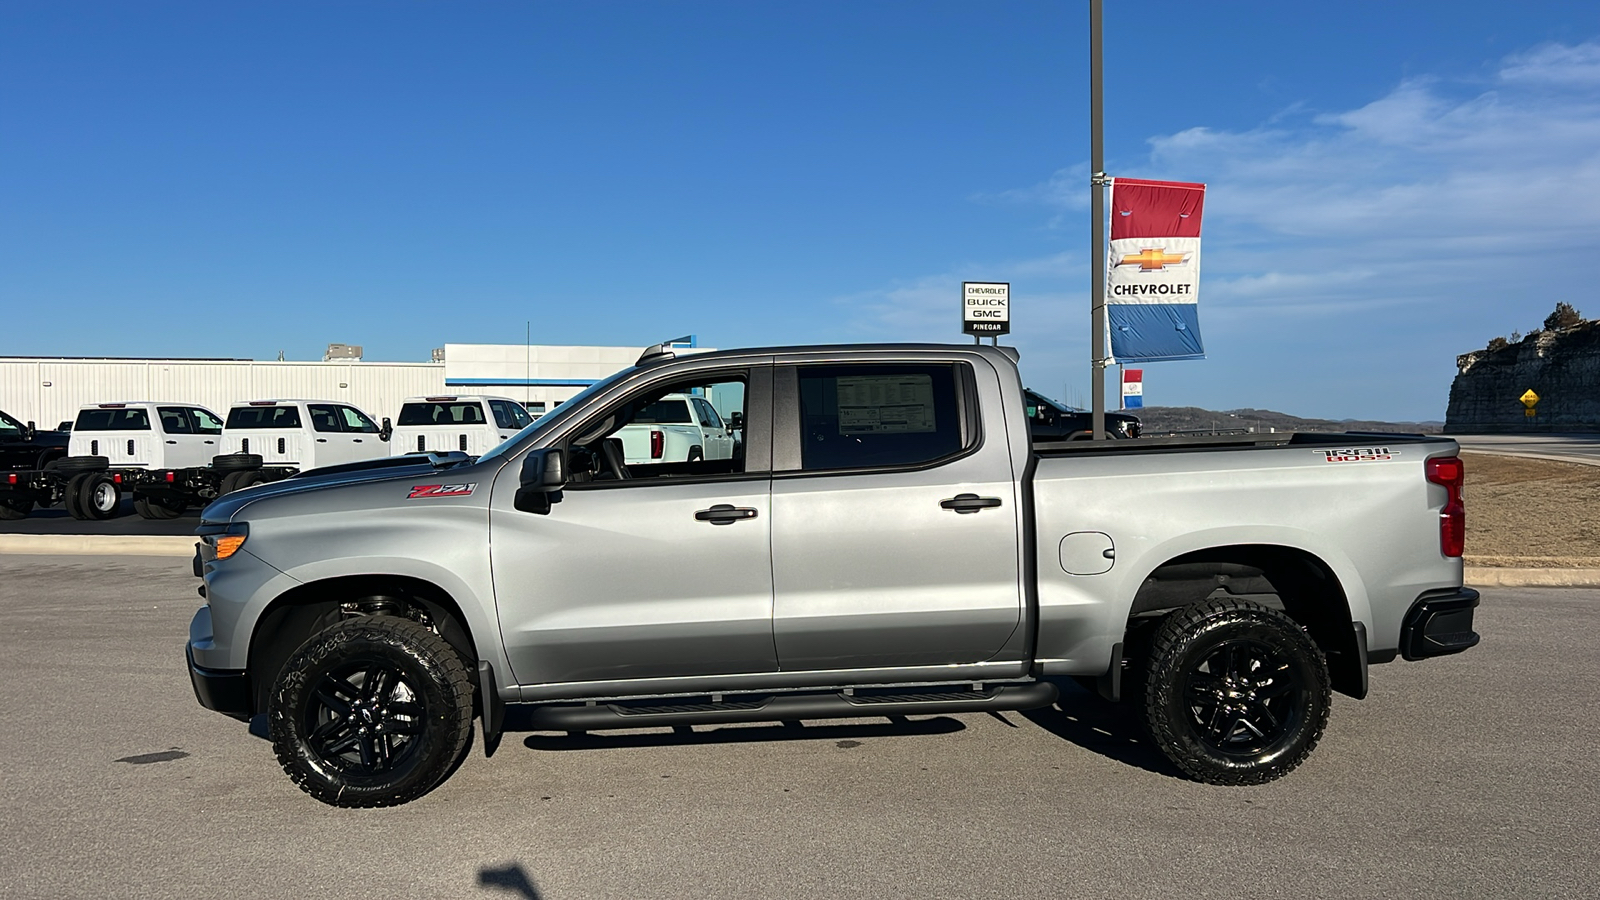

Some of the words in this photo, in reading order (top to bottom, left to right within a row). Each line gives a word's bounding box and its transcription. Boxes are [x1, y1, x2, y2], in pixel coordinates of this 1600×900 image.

[1114, 284, 1191, 295] CHEVROLET
[1313, 447, 1401, 456] TRAIL
[1326, 454, 1393, 463] BOSS
[406, 483, 478, 500] Z71
